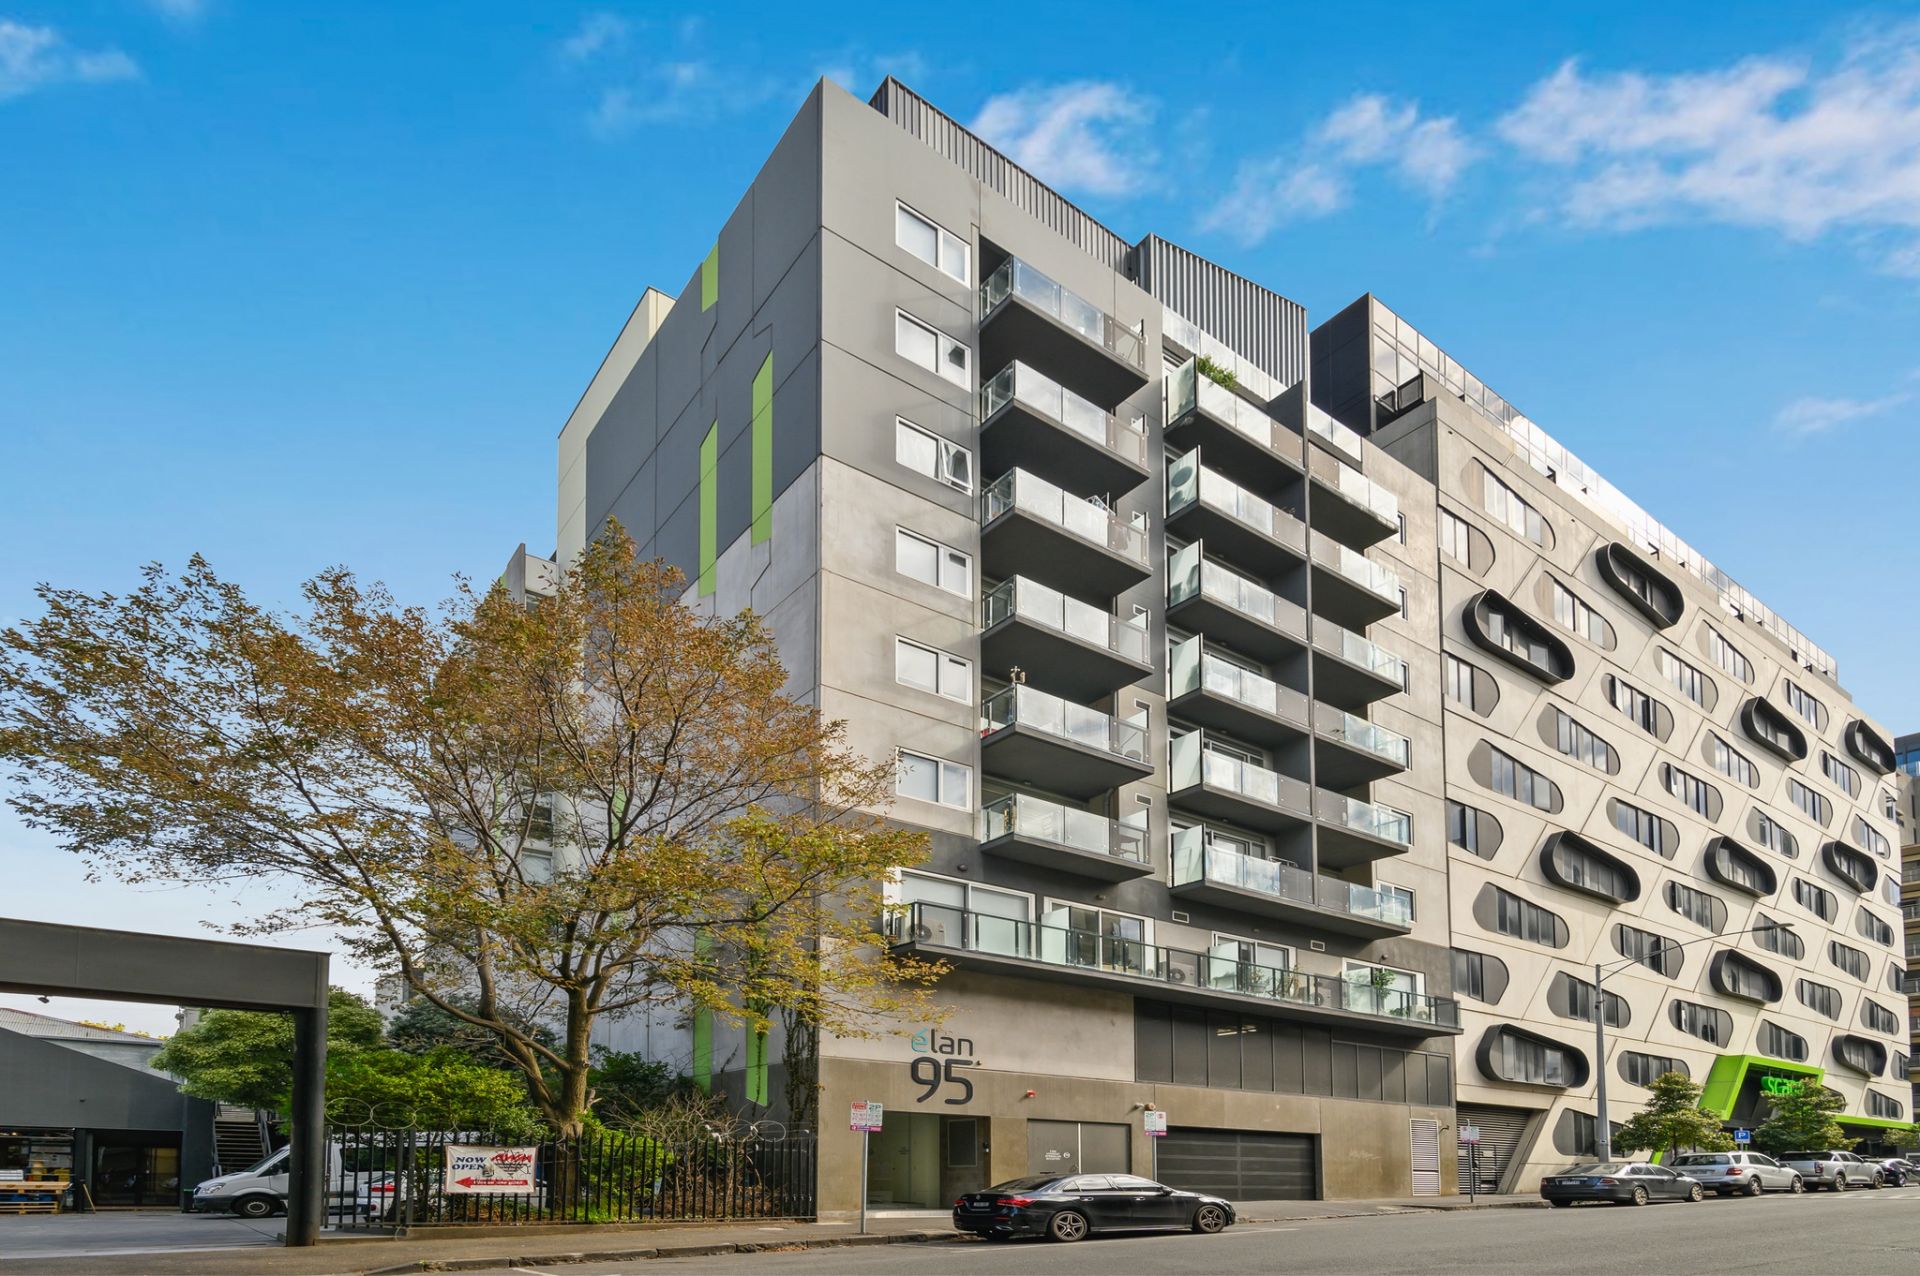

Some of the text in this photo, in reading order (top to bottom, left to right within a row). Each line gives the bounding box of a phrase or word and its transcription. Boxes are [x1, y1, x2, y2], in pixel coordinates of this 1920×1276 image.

[911, 1027, 973, 1056] élan
[911, 1056, 973, 1105] 95
[455, 1156, 487, 1164] NOW
